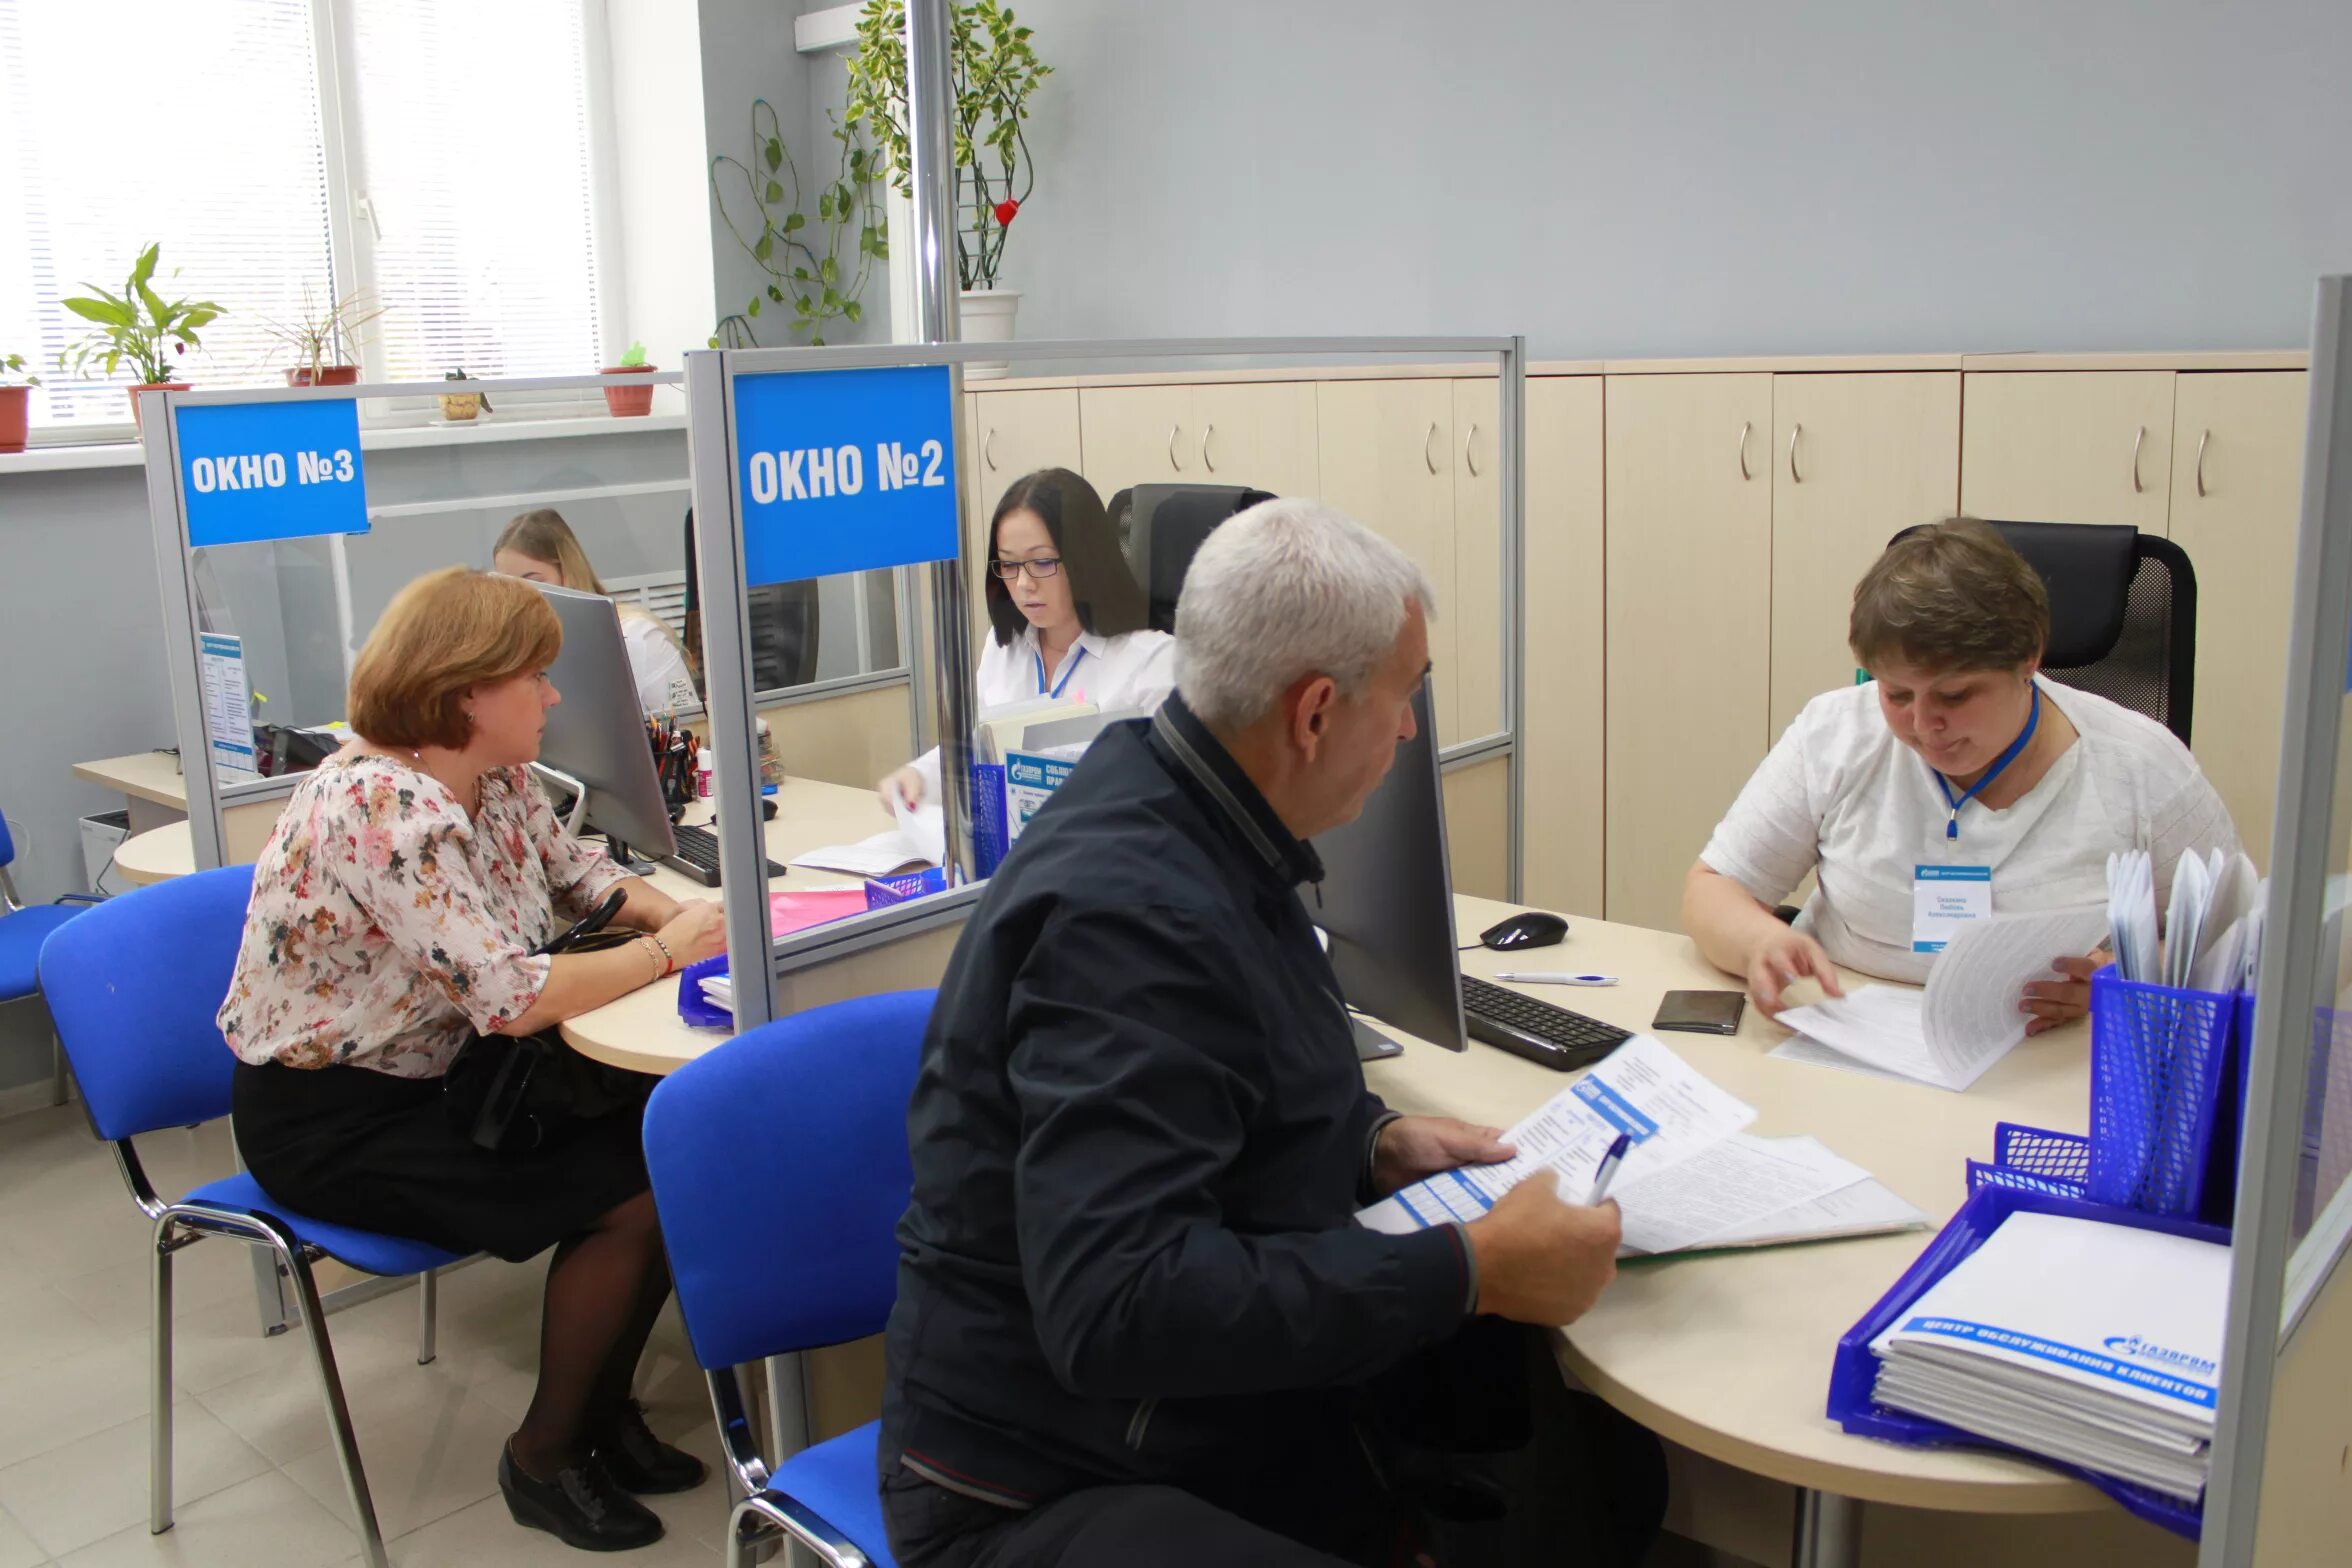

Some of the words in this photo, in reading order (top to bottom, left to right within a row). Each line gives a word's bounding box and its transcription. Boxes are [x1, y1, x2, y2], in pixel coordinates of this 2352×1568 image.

[192, 452, 287, 493] ОКНО
[296, 449, 354, 485] №3
[749, 444, 864, 504] ОКНО
[877, 439, 945, 491] №2
[1922, 1319, 1976, 1335] ЦЕНТР
[1976, 1328, 2115, 1372] ОБСЛУЖИВАНИЯ
[2115, 1364, 2209, 1400] КЛИЕНТОВ
[2141, 1343, 2217, 1368] ГАЗПРОМ
